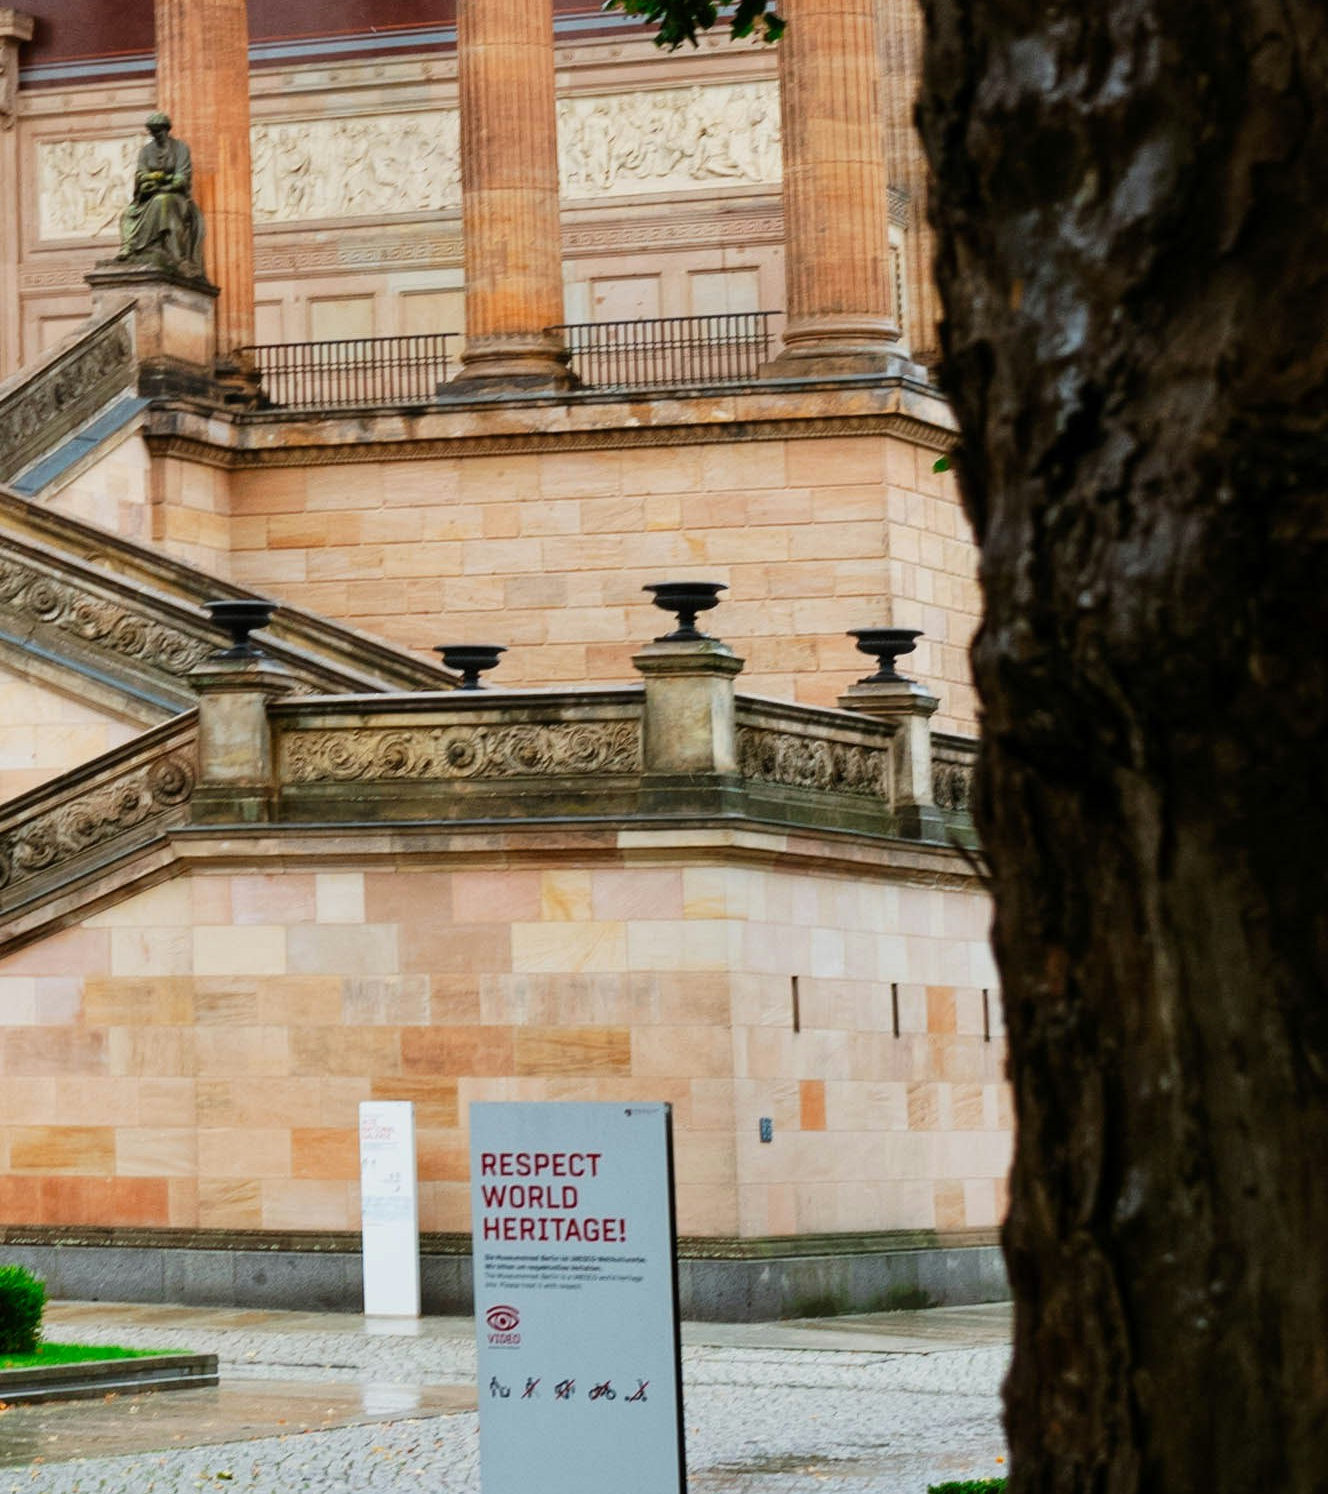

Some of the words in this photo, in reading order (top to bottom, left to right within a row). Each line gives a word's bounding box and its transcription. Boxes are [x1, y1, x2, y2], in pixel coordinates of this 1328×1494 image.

[481, 1153, 603, 1178] RESPECT
[481, 1184, 579, 1209] WORLD
[483, 1216, 627, 1243] HERITAGE!
